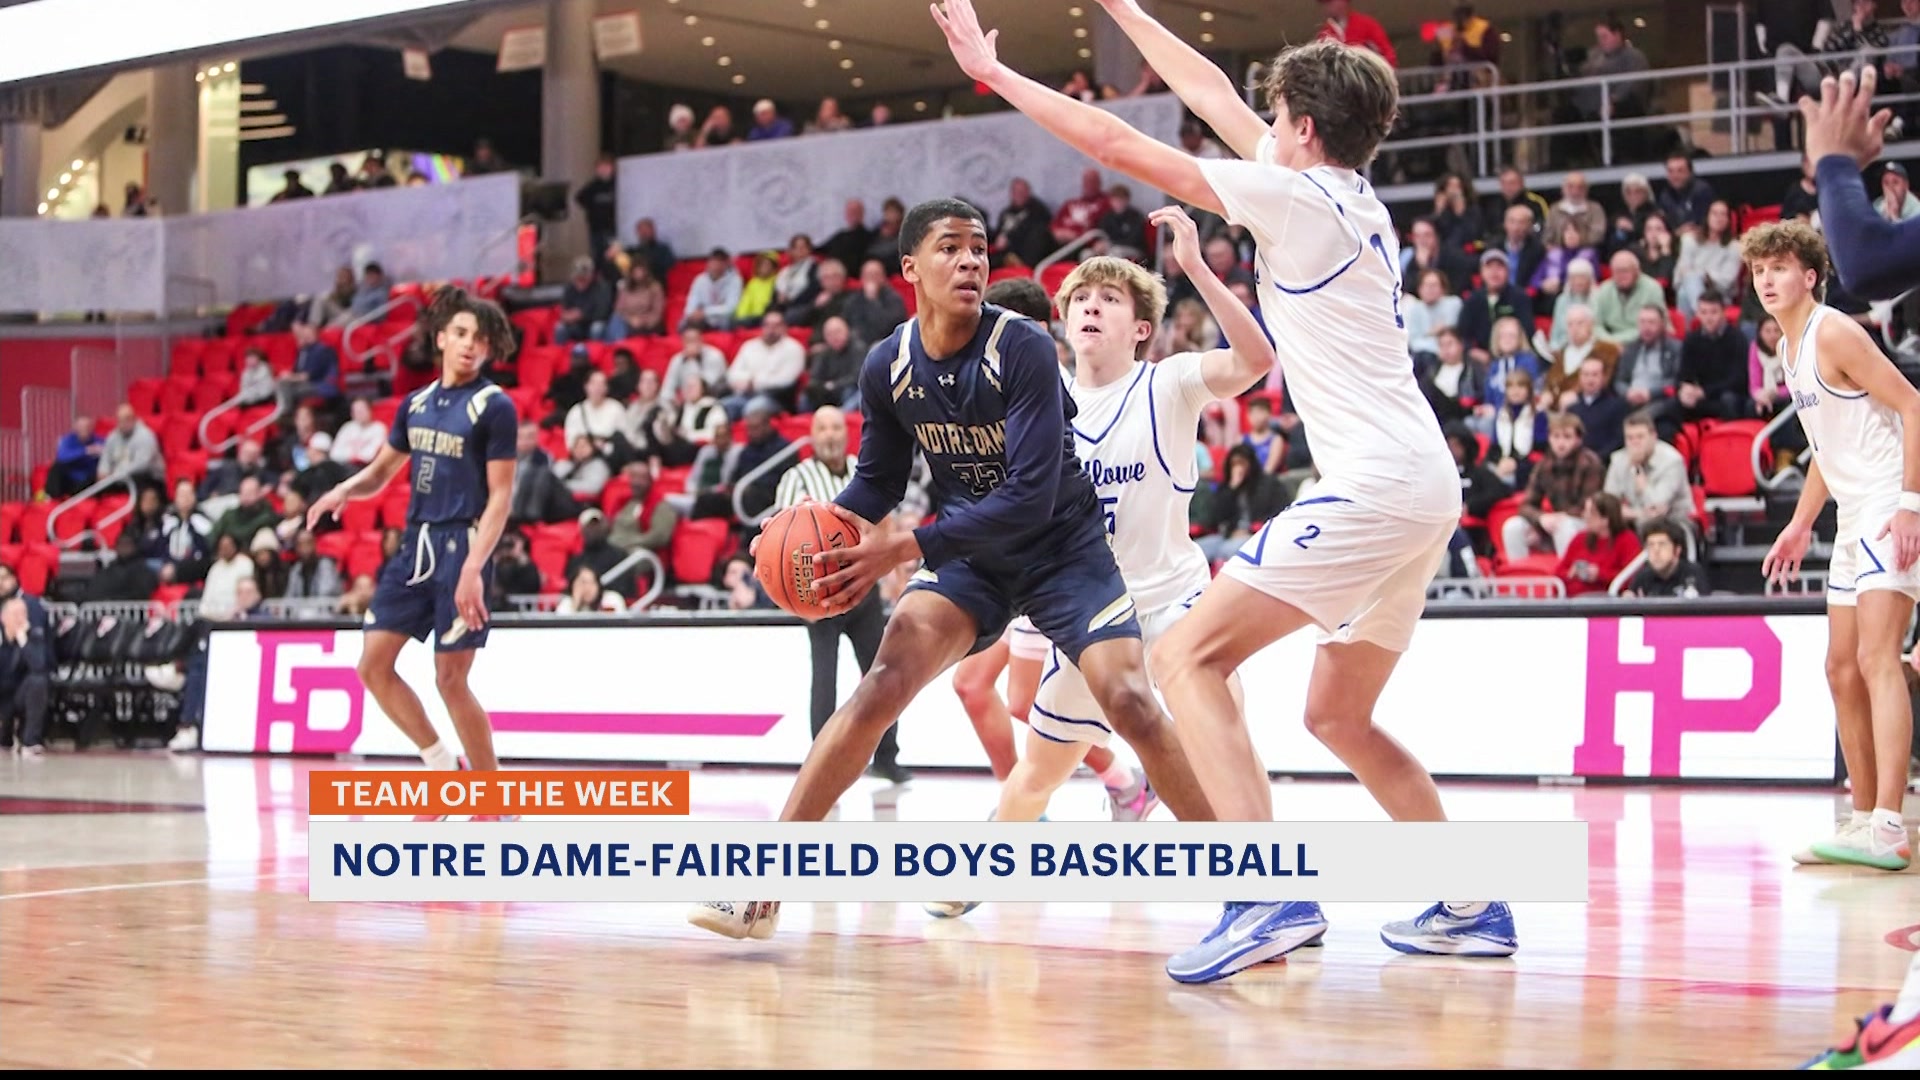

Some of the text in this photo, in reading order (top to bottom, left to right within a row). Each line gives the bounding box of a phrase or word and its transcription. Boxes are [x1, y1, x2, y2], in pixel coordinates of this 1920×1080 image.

[967, 418, 1006, 456] DAM
[416, 455, 437, 494] 2
[1293, 524, 1321, 550] 2
